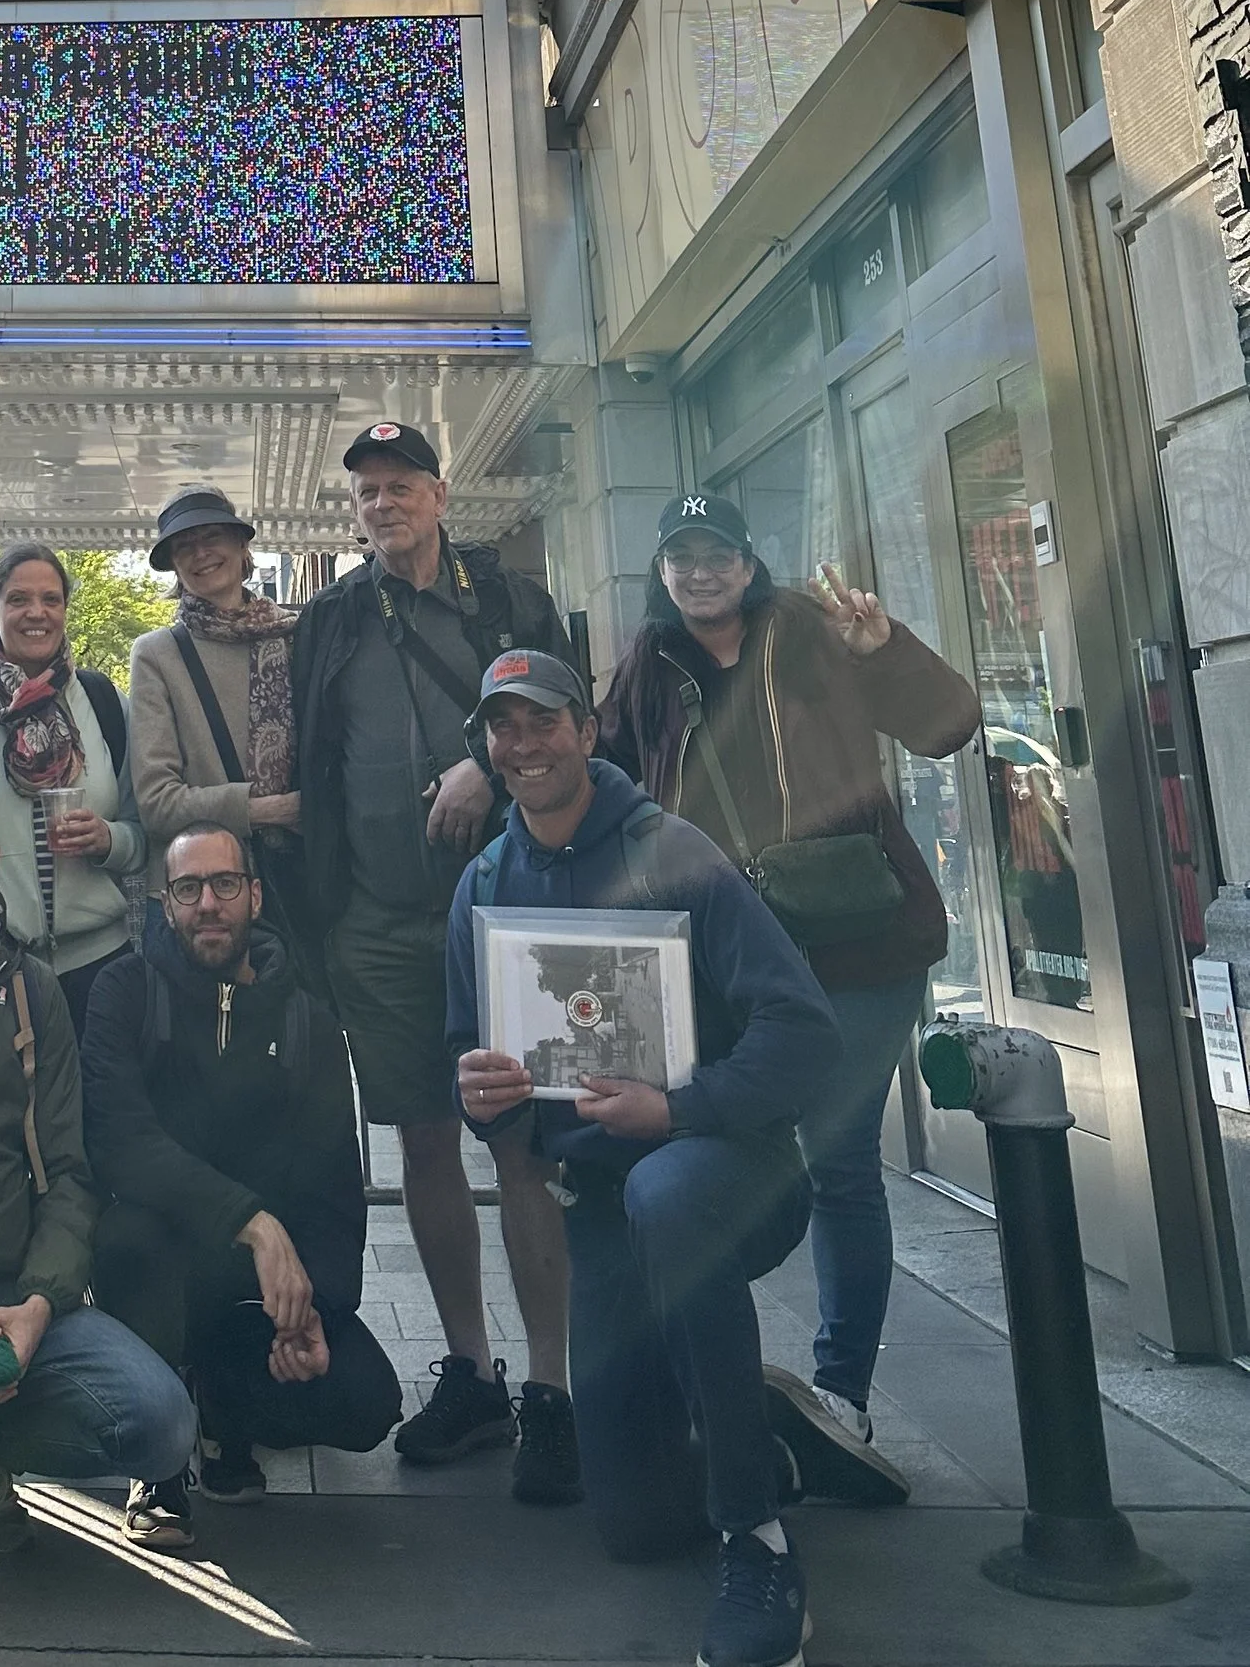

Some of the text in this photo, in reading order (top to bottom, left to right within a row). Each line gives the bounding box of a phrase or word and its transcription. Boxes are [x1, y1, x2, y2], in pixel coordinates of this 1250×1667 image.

[51, 41, 254, 97] FEATURING
[863, 248, 884, 287] 253
[681, 495, 707, 517] NY
[454, 559, 470, 589] Nikon
